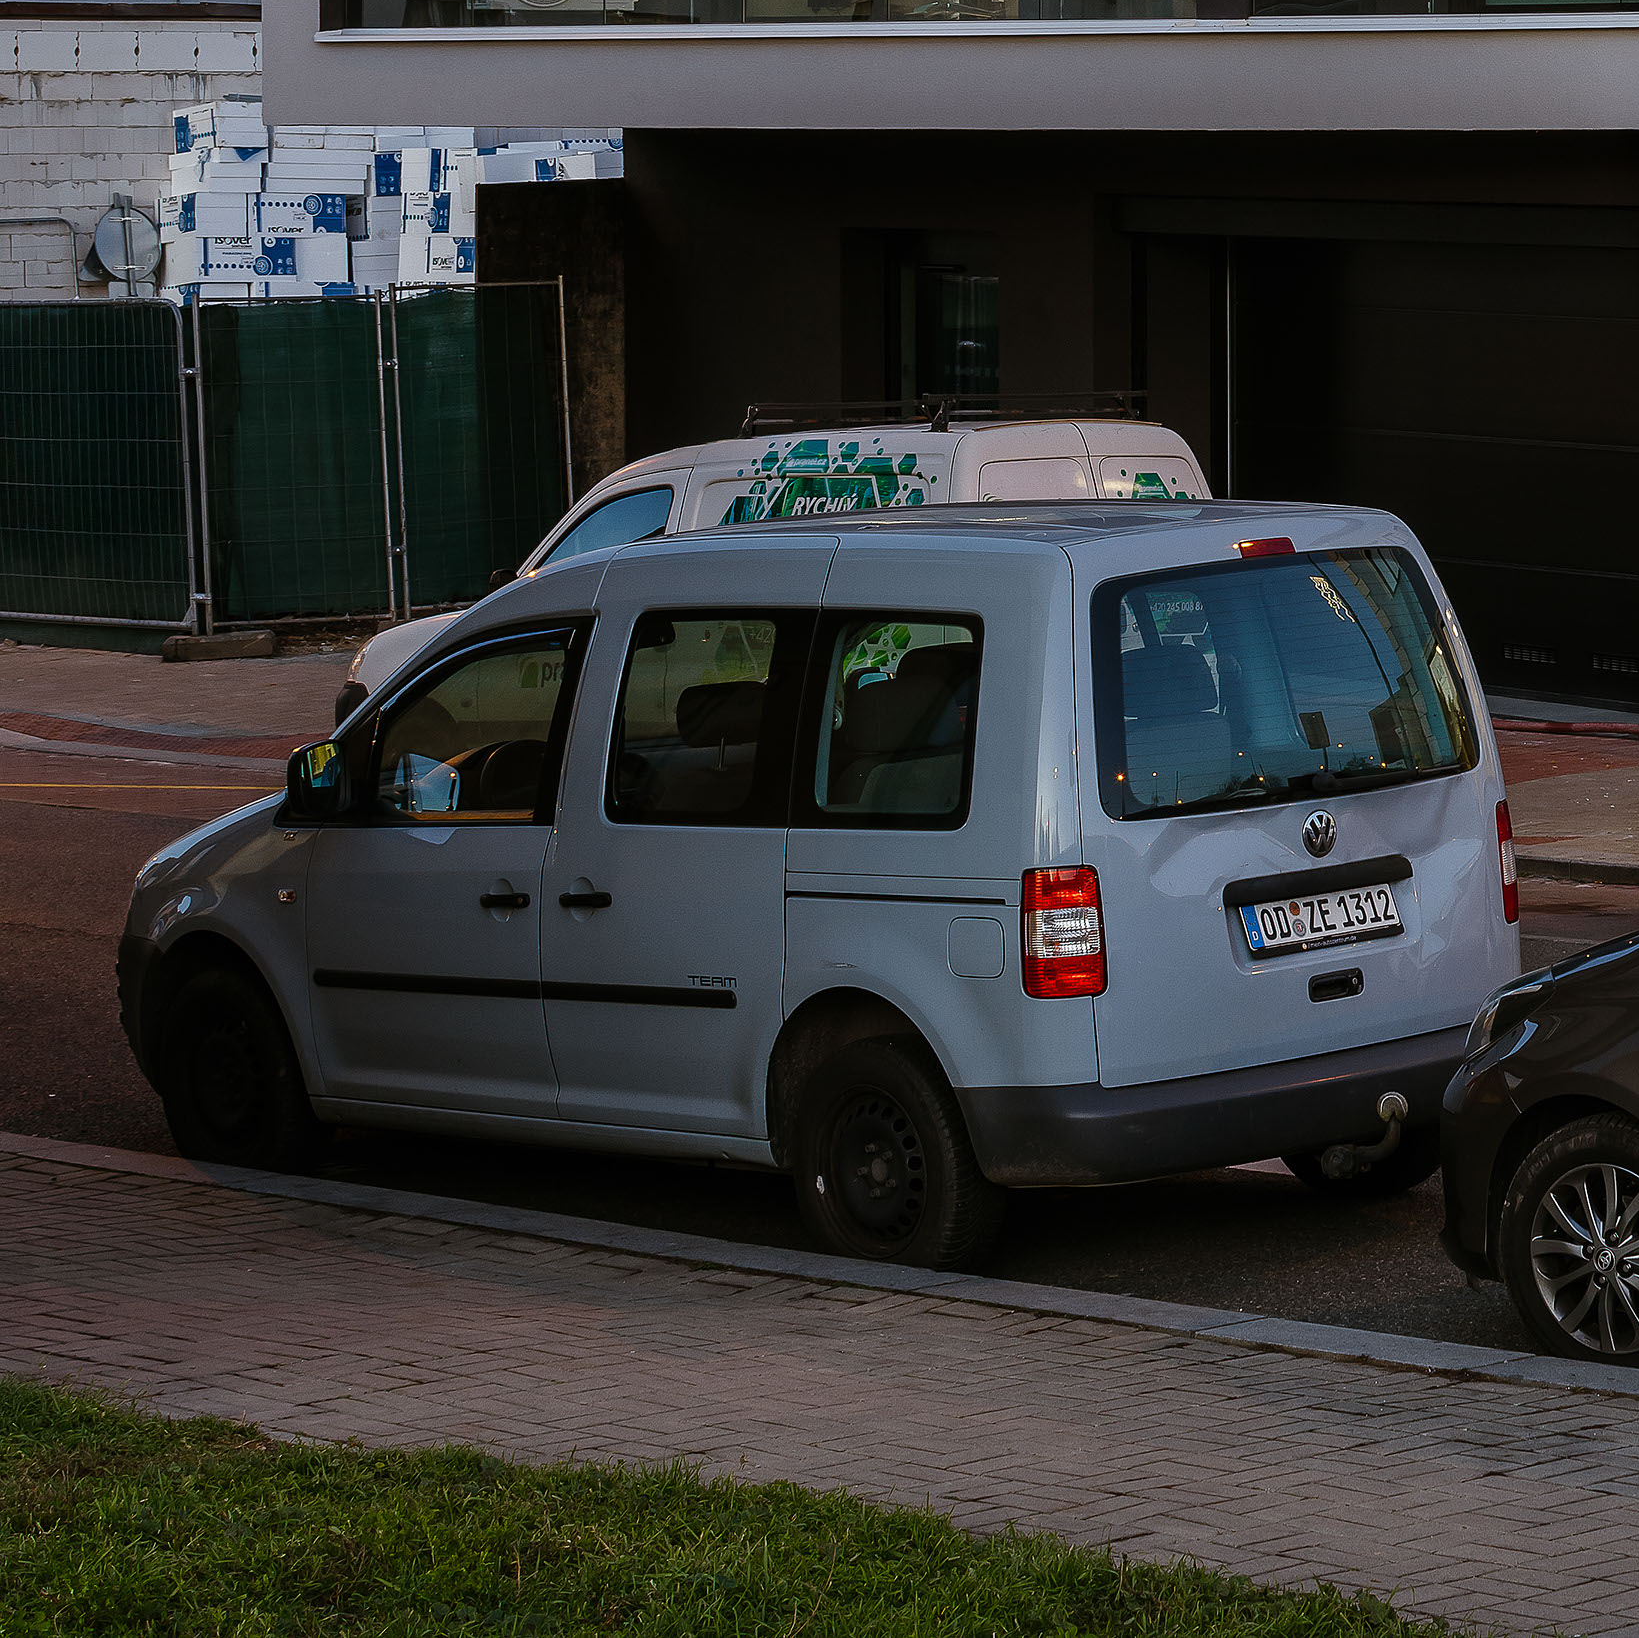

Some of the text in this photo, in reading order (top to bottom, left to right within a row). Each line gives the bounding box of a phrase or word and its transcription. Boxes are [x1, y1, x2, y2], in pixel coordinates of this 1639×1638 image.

[1260, 889, 1396, 941] OD ZE 1312
[1252, 930, 1259, 941] D
[687, 975, 738, 988] TEAM
